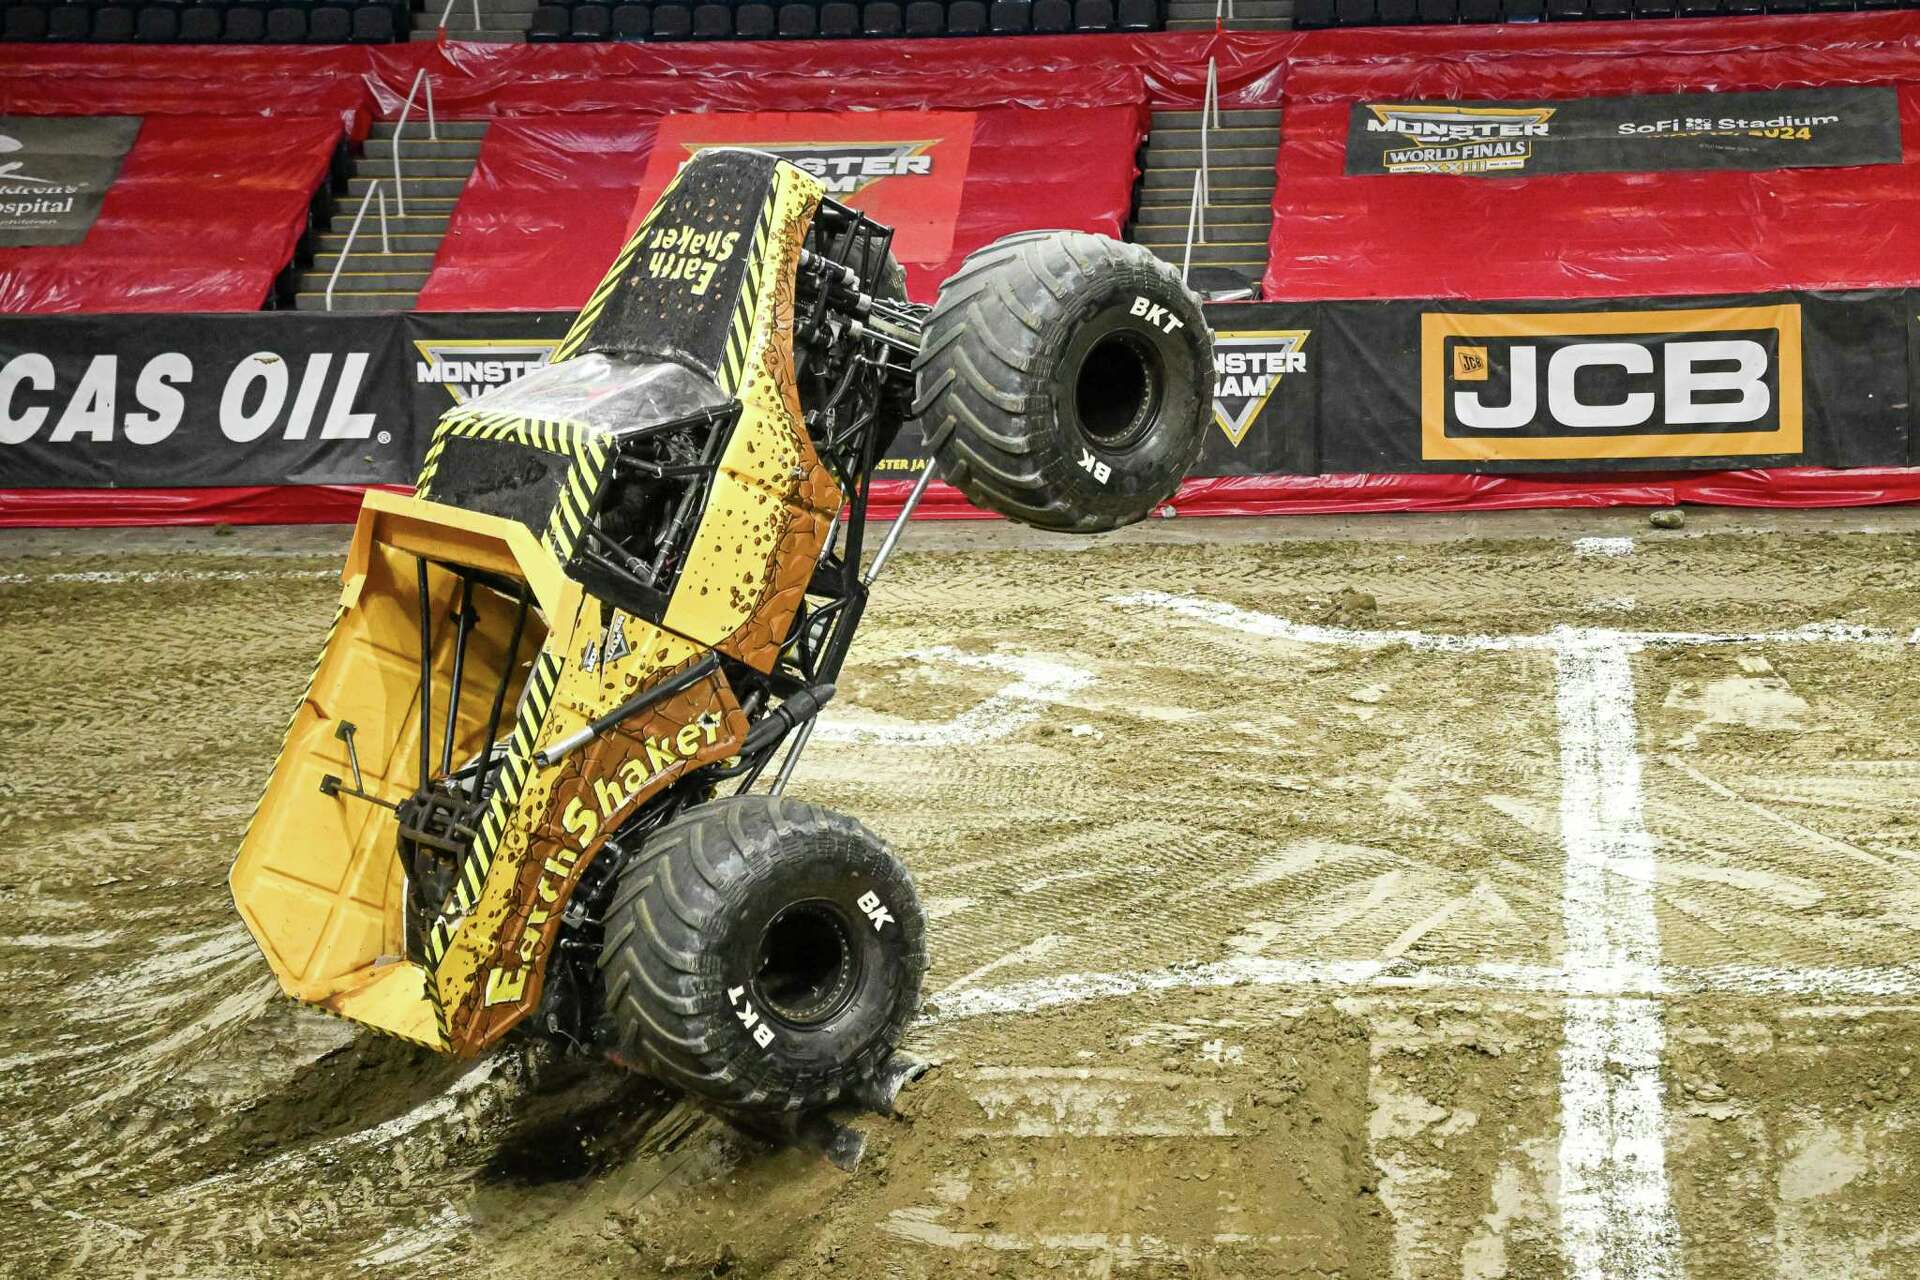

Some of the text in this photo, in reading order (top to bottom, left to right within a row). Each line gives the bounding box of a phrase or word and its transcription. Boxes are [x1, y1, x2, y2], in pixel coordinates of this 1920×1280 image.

[1367, 119, 1550, 137] MONSTER
[1617, 114, 1840, 135] SoFi Stadium
[1390, 141, 1526, 164] WORLD FINALS
[649, 225, 741, 262] Shaker
[649, 251, 718, 295] Earth
[1129, 296, 1185, 334] BKT
[1214, 352, 1307, 374] NSTER
[0, 352, 376, 445] CAS OIL
[1454, 340, 1770, 429] JCB
[876, 458, 927, 472] STER JA
[1077, 448, 1112, 485] BK
[856, 890, 895, 932] BK
[728, 985, 776, 1049] BKT
